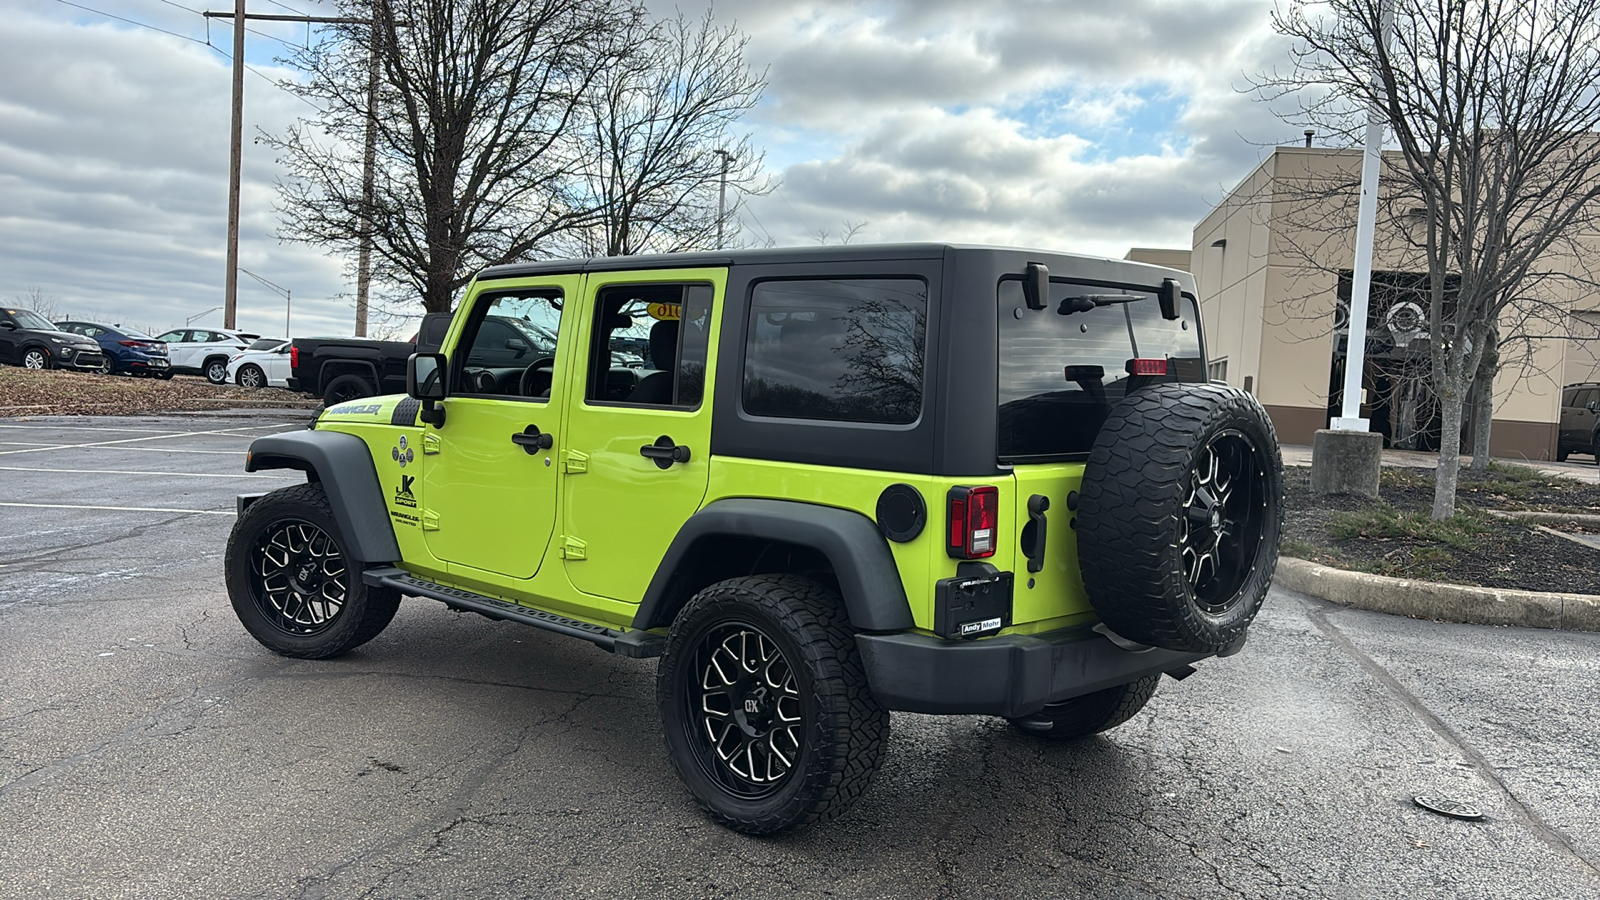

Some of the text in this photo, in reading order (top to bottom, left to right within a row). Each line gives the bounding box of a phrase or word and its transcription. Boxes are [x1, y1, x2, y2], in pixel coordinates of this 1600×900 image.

[330, 404, 382, 415] WRANGLER
[391, 510, 419, 522] WRANGLER
[964, 620, 1000, 632] Andy Mohr
